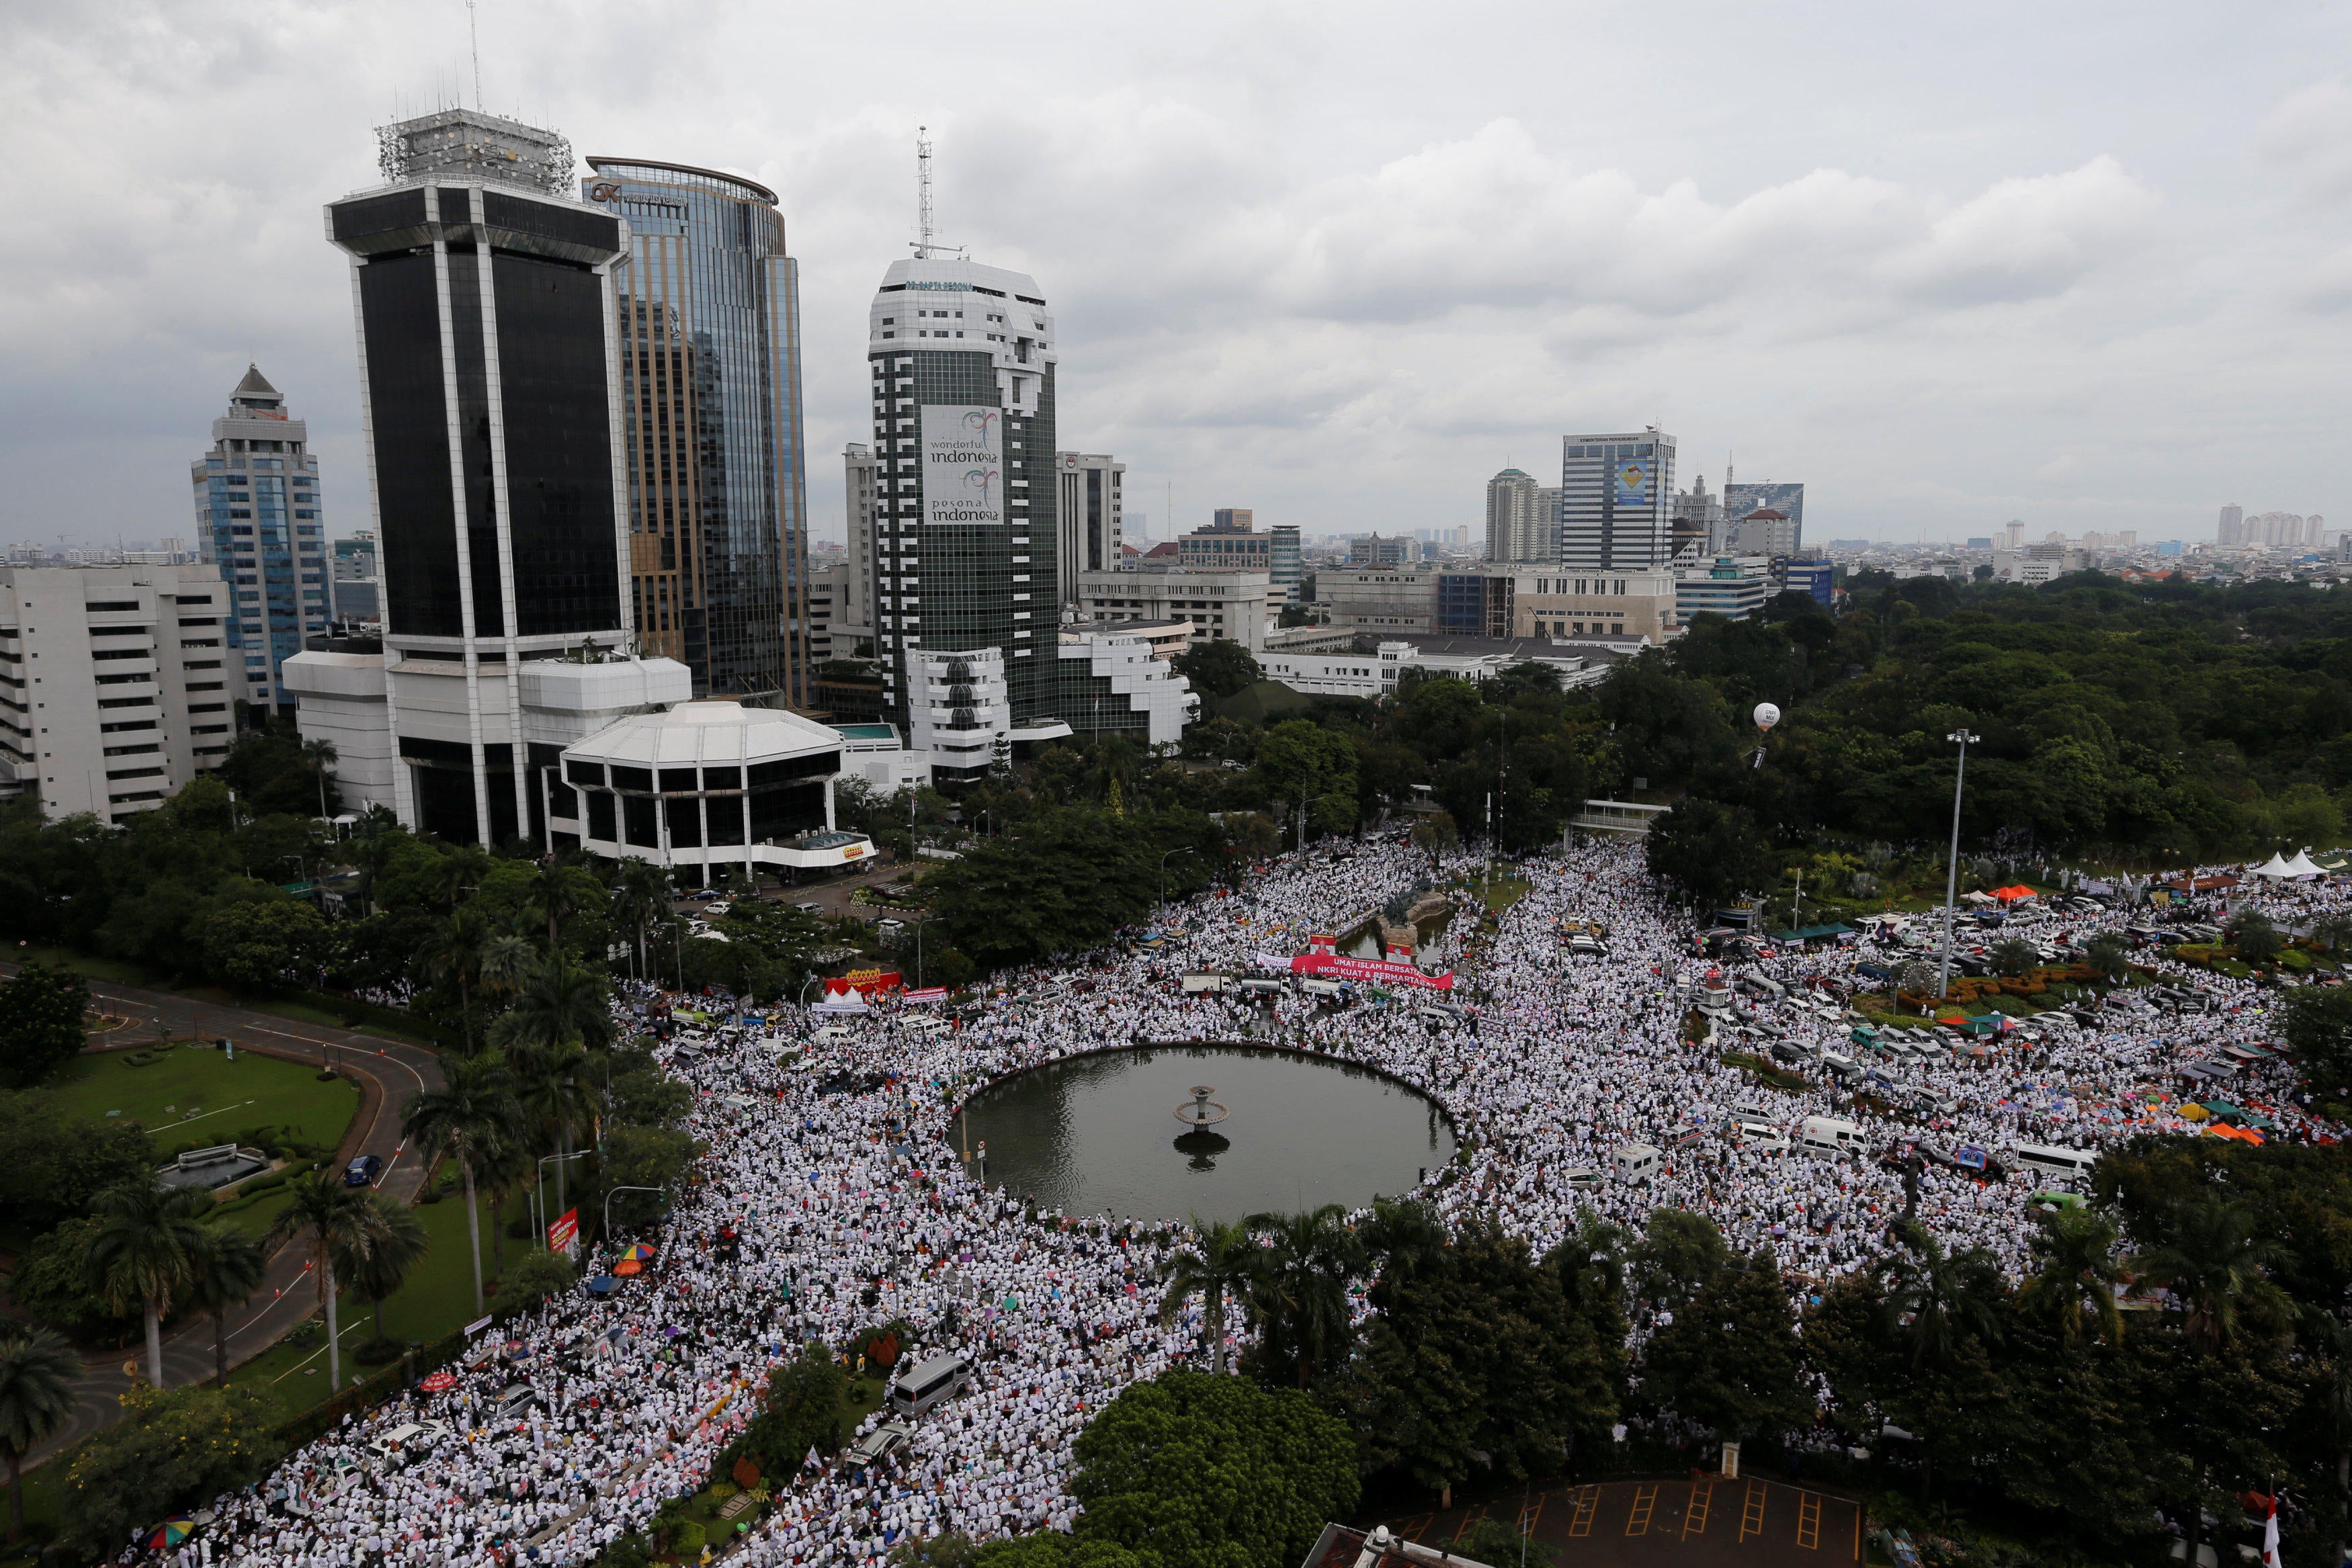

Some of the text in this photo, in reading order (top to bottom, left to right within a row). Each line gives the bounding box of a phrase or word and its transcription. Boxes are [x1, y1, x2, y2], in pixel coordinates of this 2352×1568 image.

[919, 281, 941, 290] SAPTA
[943, 281, 972, 291] PESONA
[931, 440, 983, 449] wonderful
[930, 449, 998, 464] indonesia
[931, 500, 982, 509] pesona
[932, 508, 999, 521] indonesia
[1334, 958, 1355, 967] UMAT
[1357, 959, 1382, 970] ISLAM
[1317, 966, 1339, 974] NKRI
[1340, 969, 1363, 977] KUAT
[1373, 972, 1437, 988] BERMARTABAT
